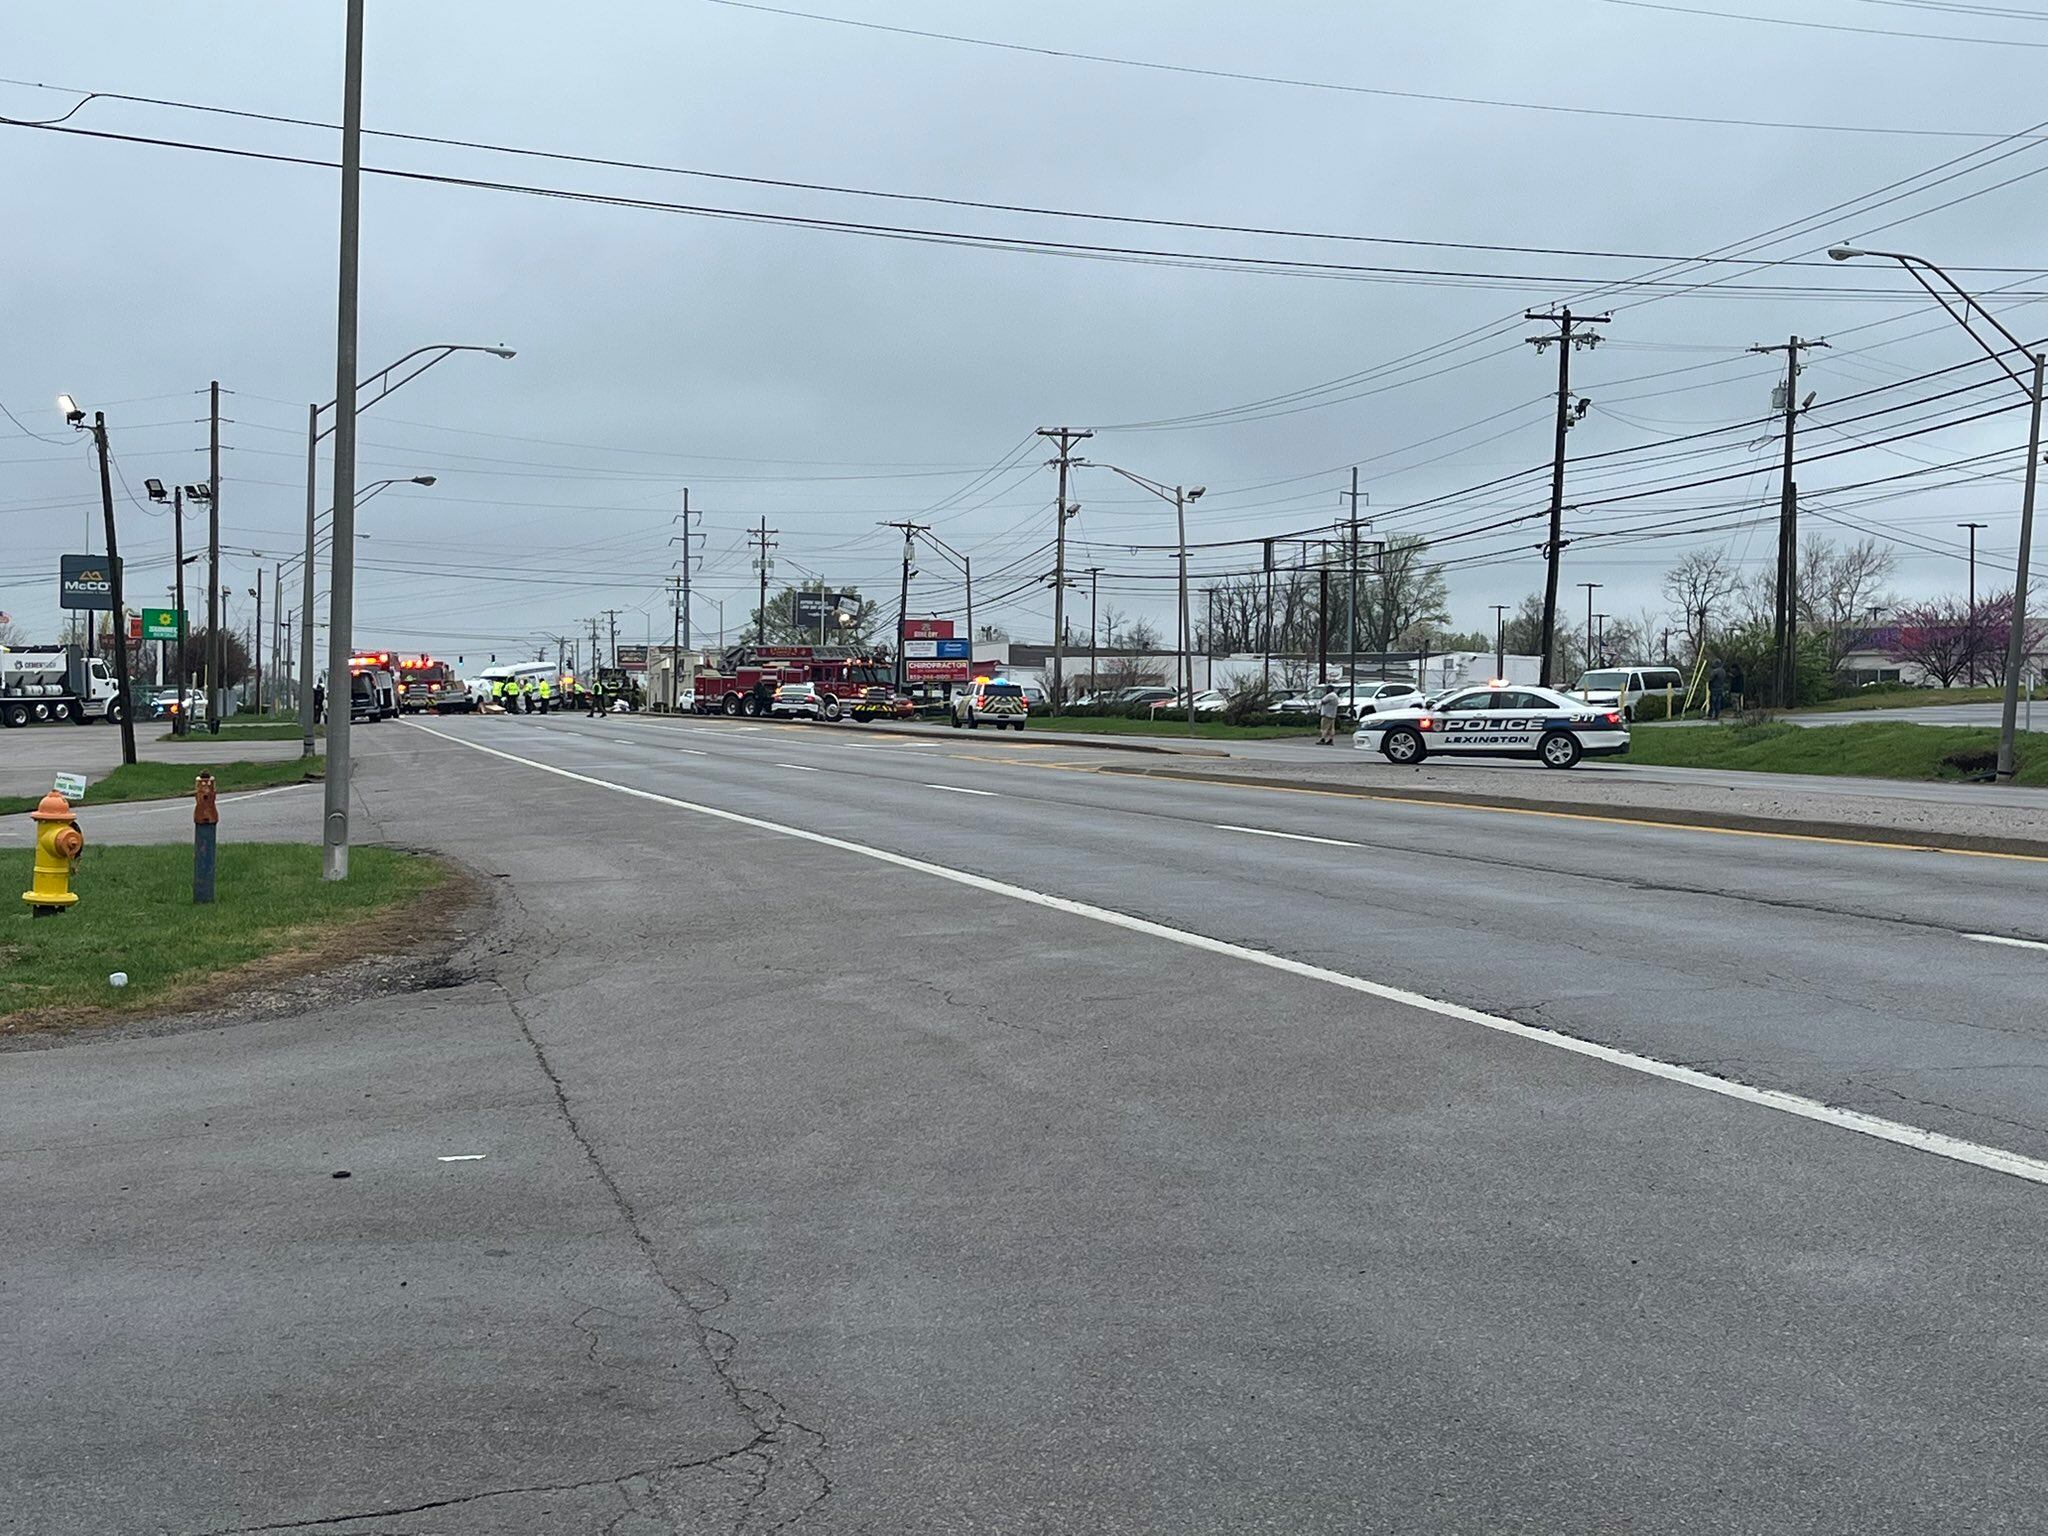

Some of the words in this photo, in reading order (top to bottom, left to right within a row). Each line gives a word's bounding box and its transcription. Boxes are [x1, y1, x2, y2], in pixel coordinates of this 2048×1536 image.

[1569, 713, 1597, 722] 911
[1444, 719, 1546, 731] POLICE
[1444, 736, 1530, 744] LEXINGTON
